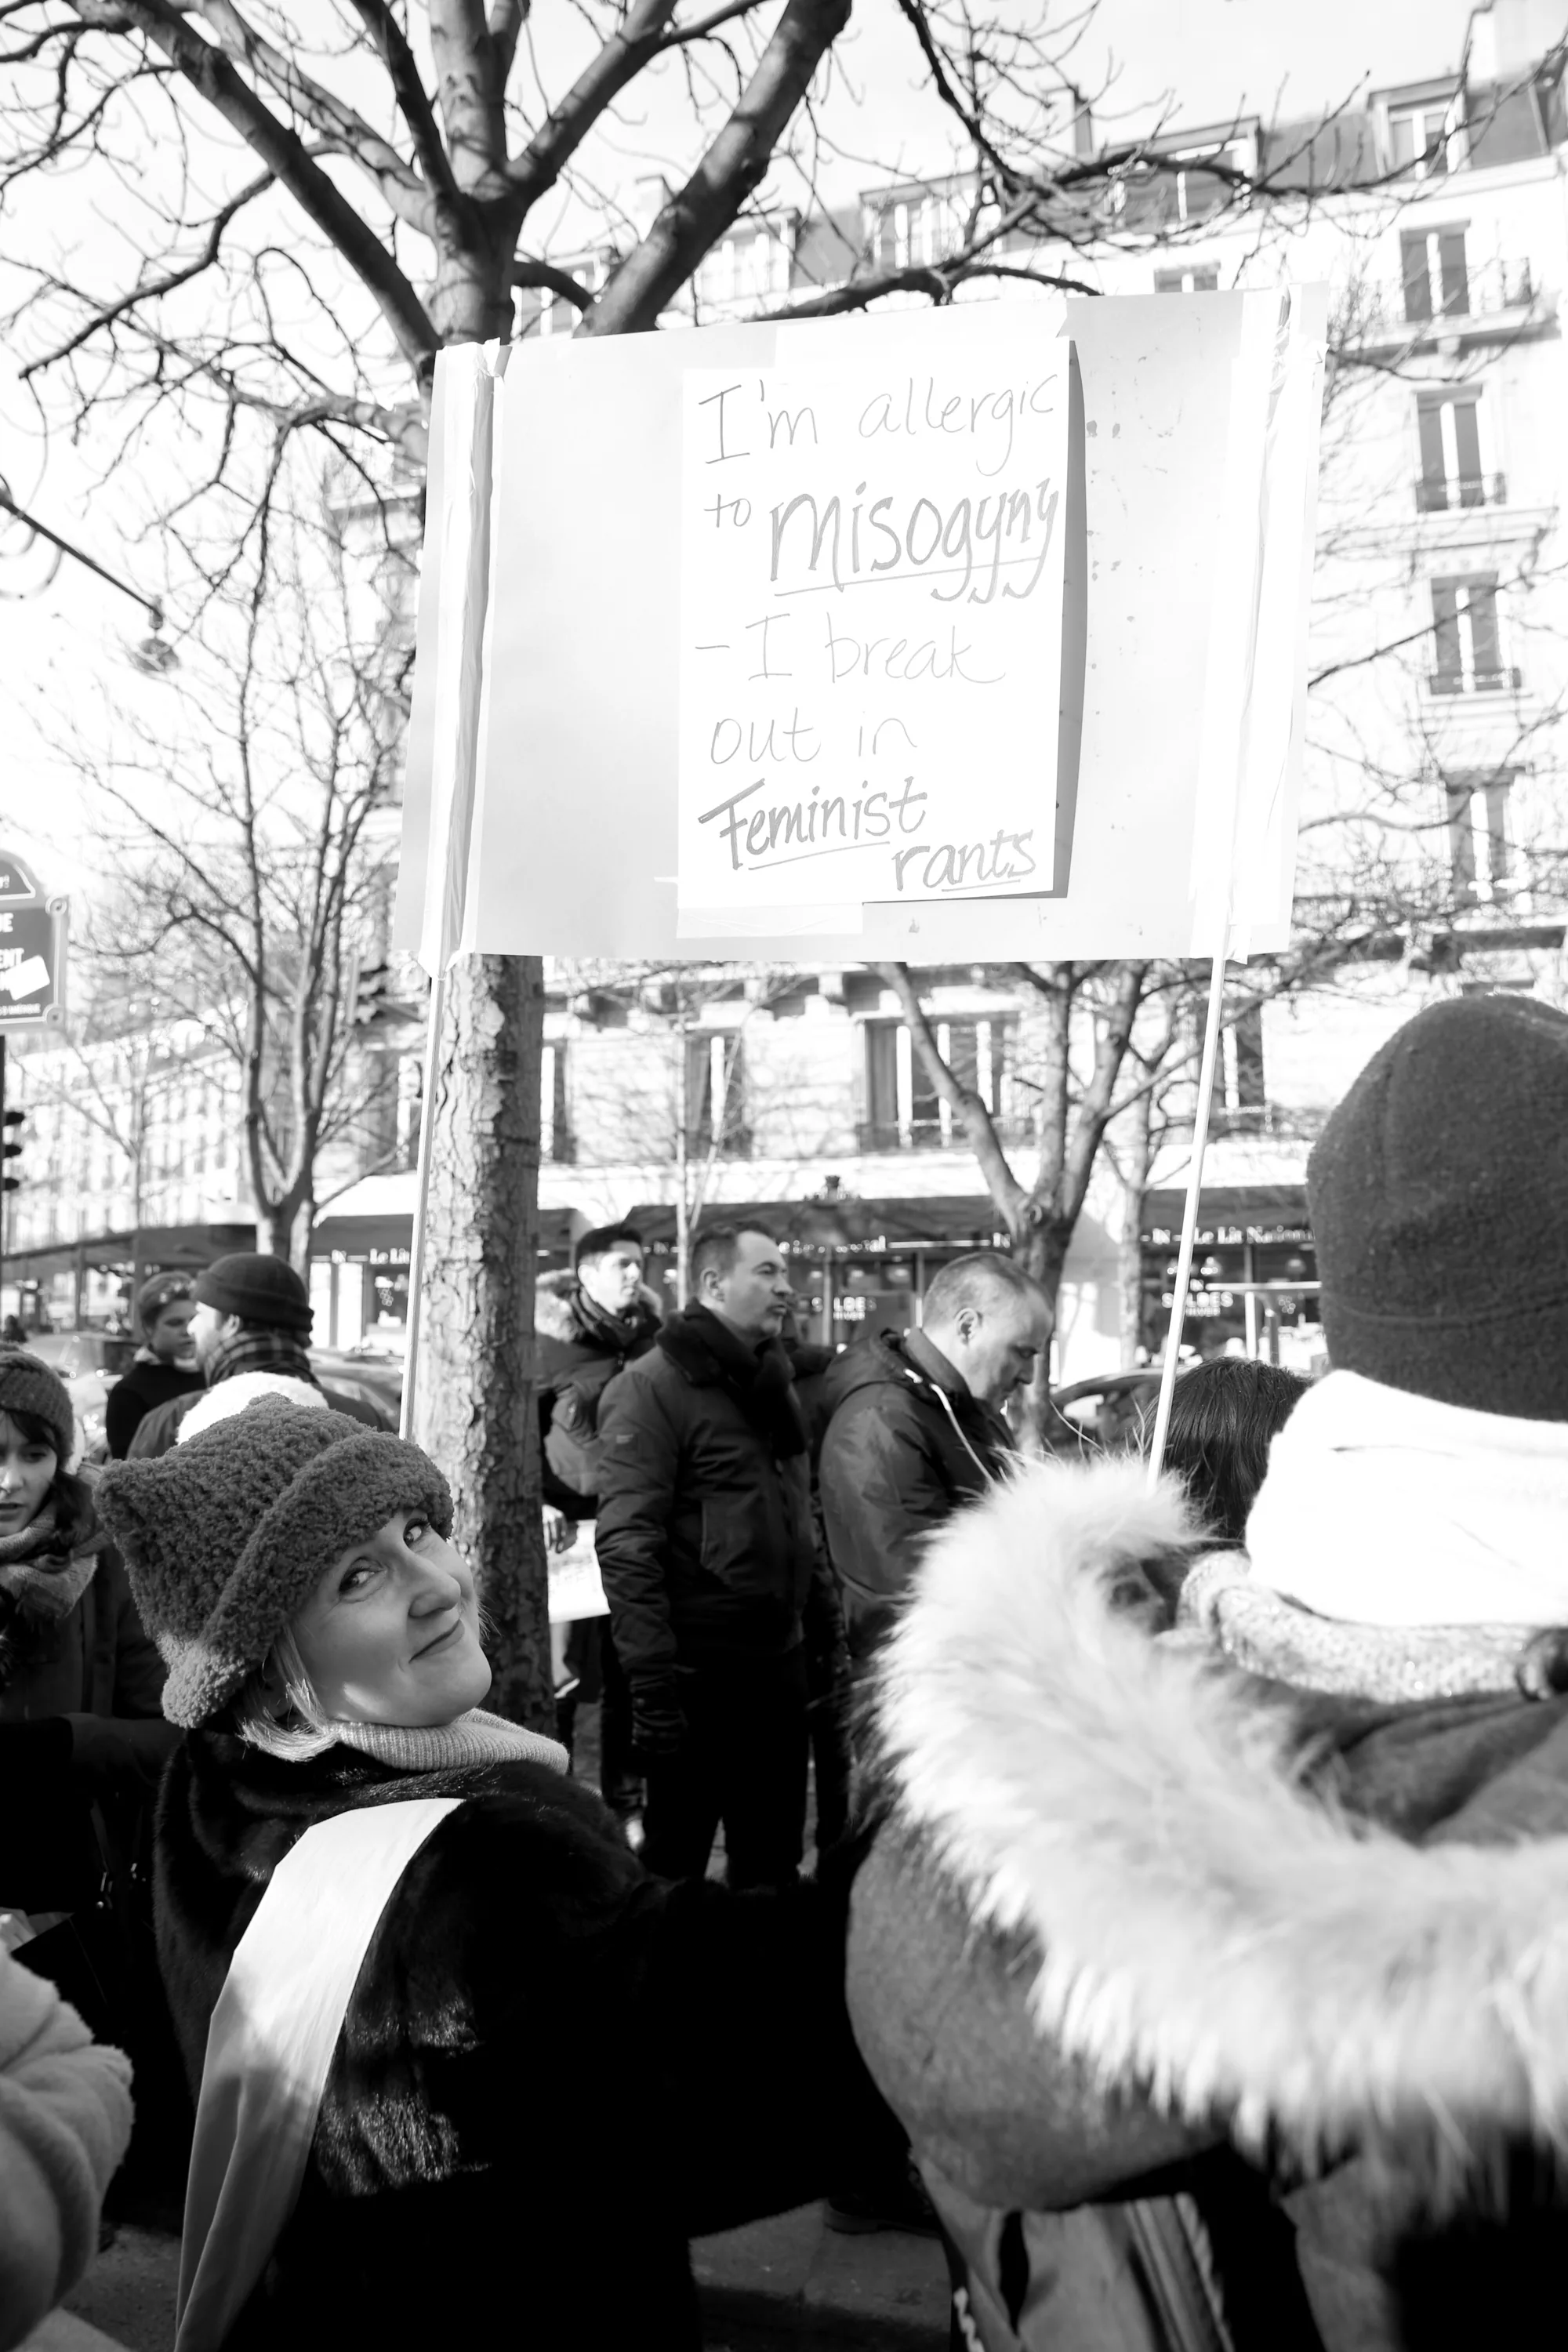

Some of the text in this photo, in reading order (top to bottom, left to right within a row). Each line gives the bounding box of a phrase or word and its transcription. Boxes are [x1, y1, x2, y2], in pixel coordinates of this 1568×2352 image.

[699, 374, 1058, 477] I'm allergic
[704, 494, 752, 528] to
[824, 612, 1007, 684] break
[710, 707, 918, 764] out in
[698, 776, 927, 870] Feminist
[891, 829, 1037, 891] rants
